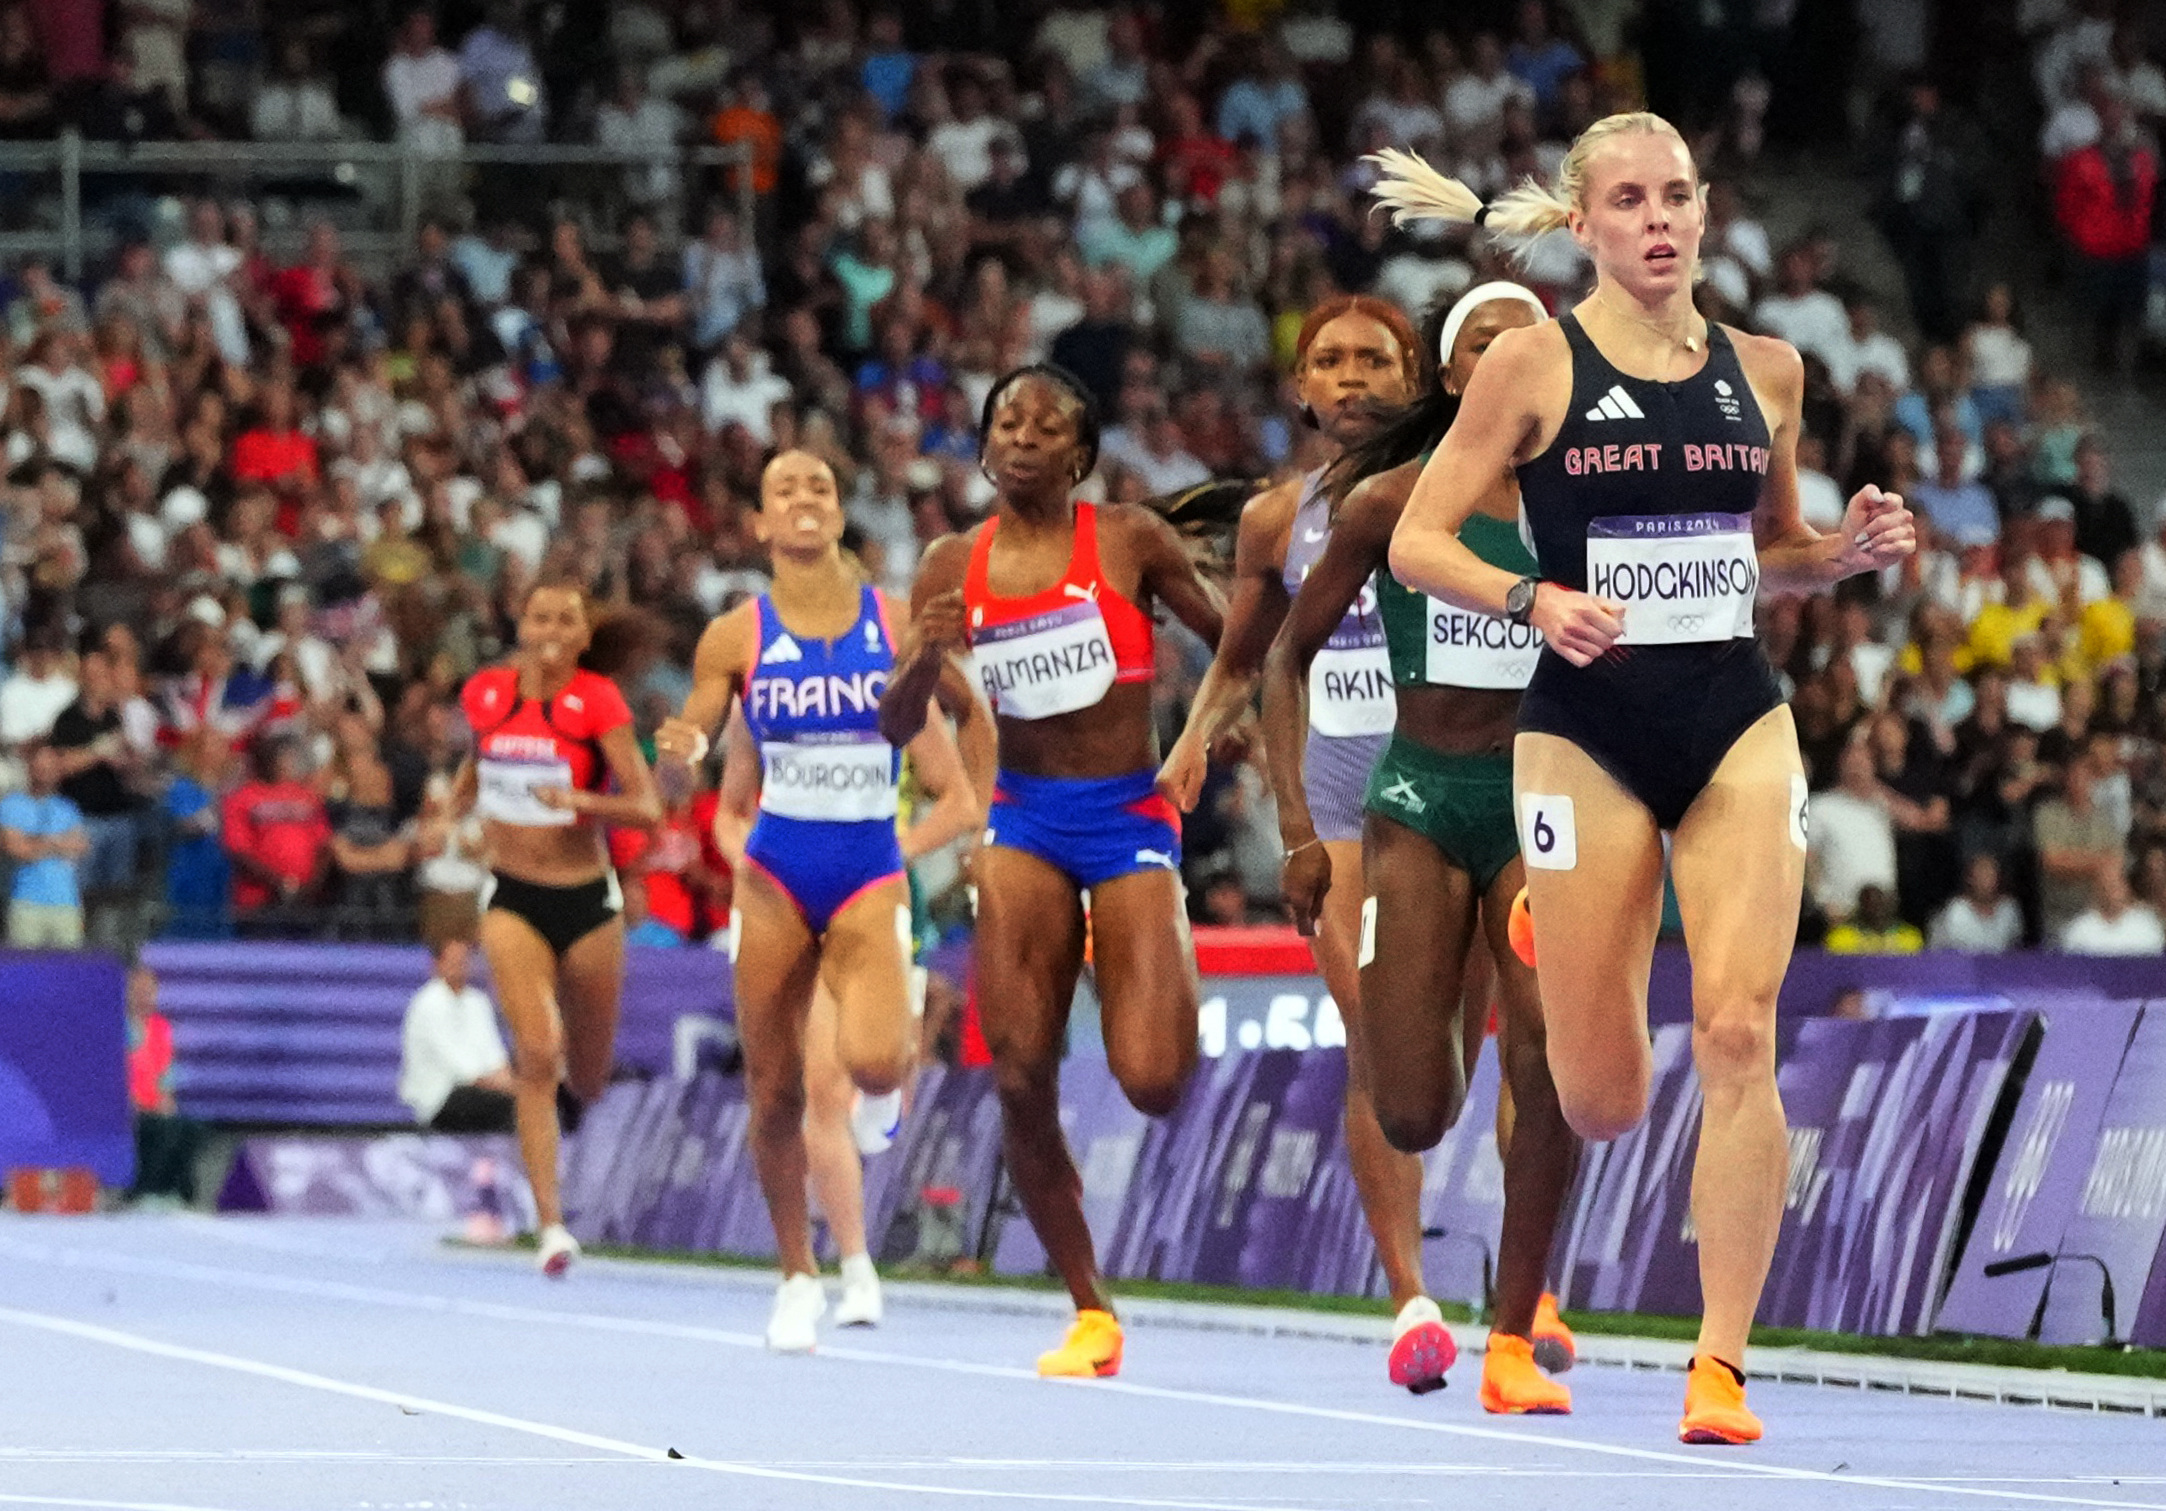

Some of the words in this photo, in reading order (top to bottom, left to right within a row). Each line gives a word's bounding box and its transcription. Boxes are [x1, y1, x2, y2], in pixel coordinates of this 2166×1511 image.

[1565, 444, 1662, 476] GREAT
[1636, 520, 1681, 533] PARIS
[1595, 558, 1756, 600] HODGKINSON
[980, 638, 1110, 693] ALMANZA
[752, 671, 890, 719] FRANC
[771, 756, 886, 790] BOURGOIN
[1534, 811, 1555, 853] 6
